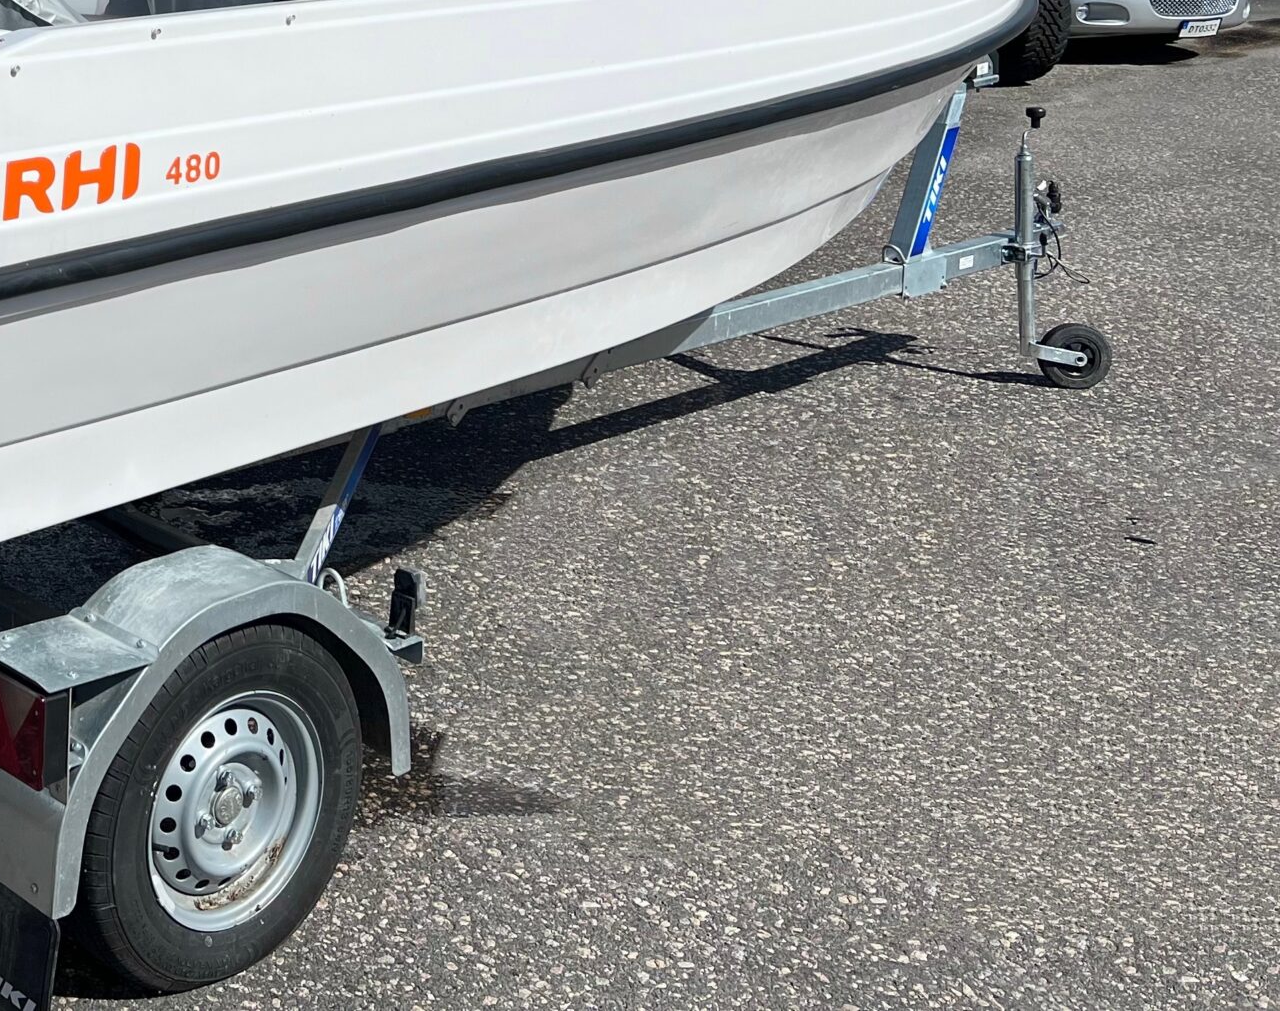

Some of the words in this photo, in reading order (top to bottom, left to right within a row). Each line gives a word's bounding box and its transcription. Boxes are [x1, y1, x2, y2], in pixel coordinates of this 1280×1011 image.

[166, 151, 221, 184] 480
[923, 155, 947, 223] TIKI
[310, 512, 336, 584] TIKI
